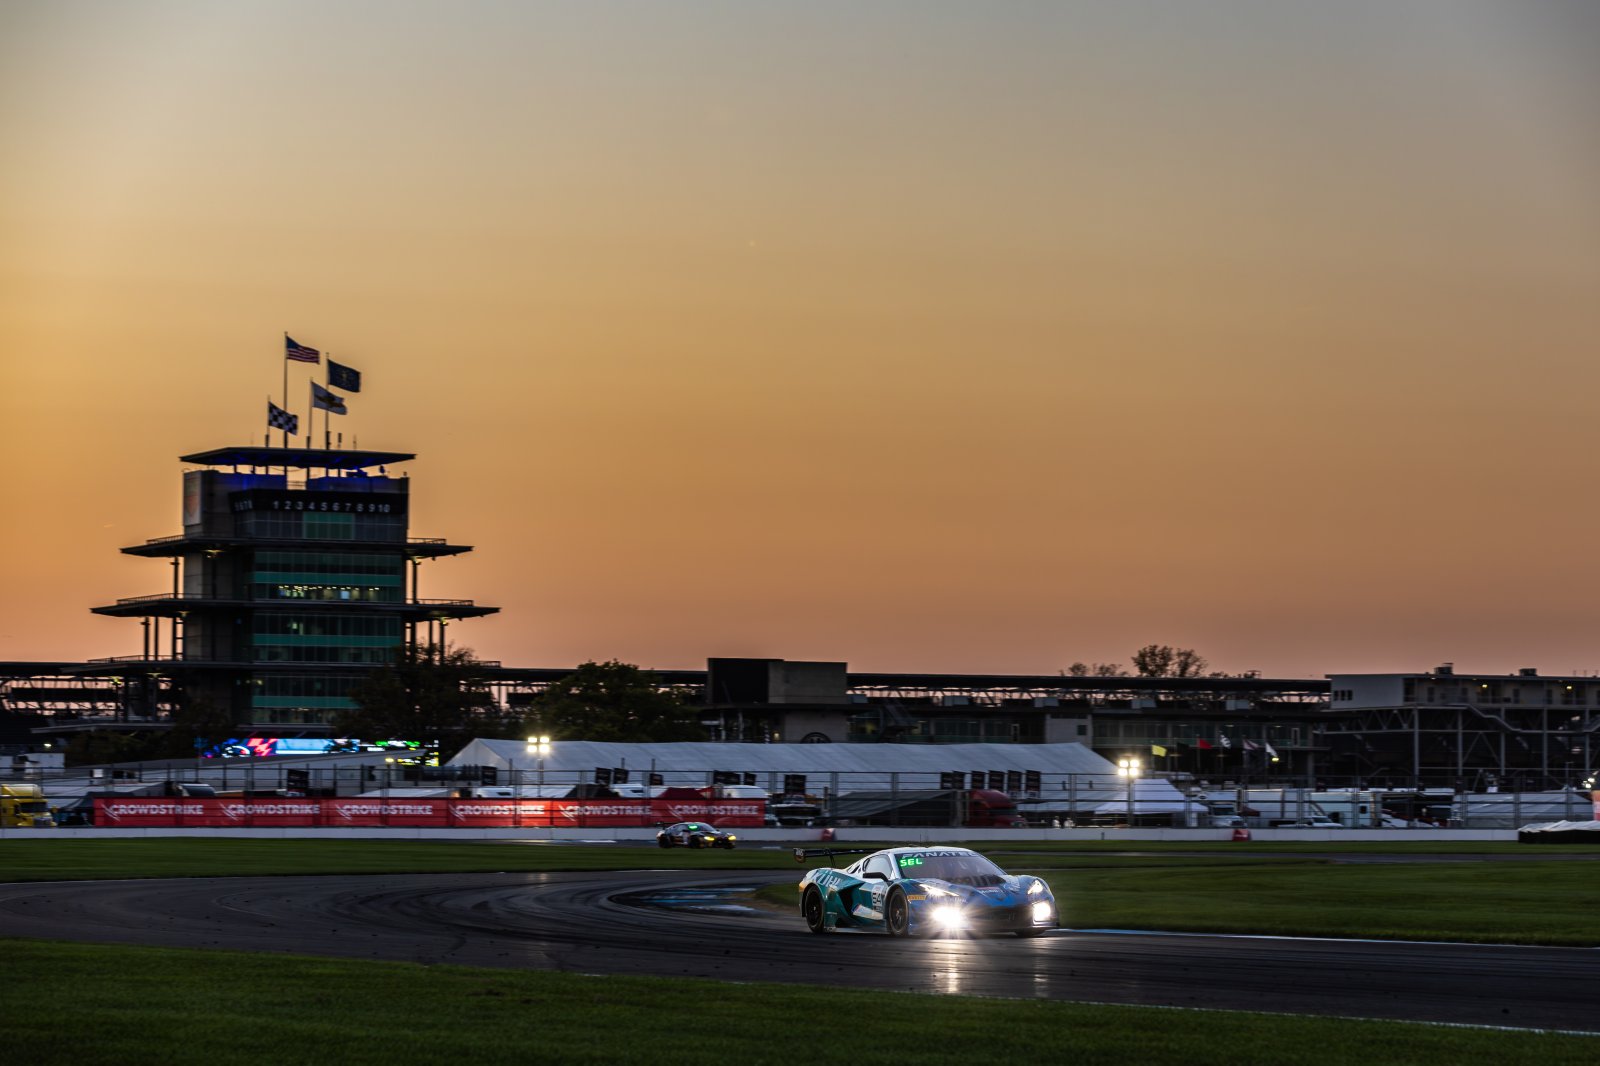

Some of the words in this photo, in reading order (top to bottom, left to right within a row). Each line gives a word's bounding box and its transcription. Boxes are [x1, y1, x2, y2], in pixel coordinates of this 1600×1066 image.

[272, 500, 279, 510] 1
[284, 500, 292, 510] 2
[295, 501, 304, 510] 3
[308, 501, 316, 511] 4
[320, 502, 328, 511] 5
[332, 502, 340, 511] 6
[344, 503, 352, 512] 7
[356, 503, 364, 512] 8
[368, 503, 376, 513] 9
[377, 503, 391, 513] 10
[111, 804, 204, 815] CROWDSTRIKE
[228, 804, 320, 815] CROWDSTRIKE
[343, 804, 433, 815] CROWDSTRIKE
[456, 805, 545, 815] CROWDSTRIKE
[566, 805, 652, 815] CROWDSTRIKE
[675, 805, 758, 815] CROWDSTRIKE
[900, 858, 923, 867] SEL
